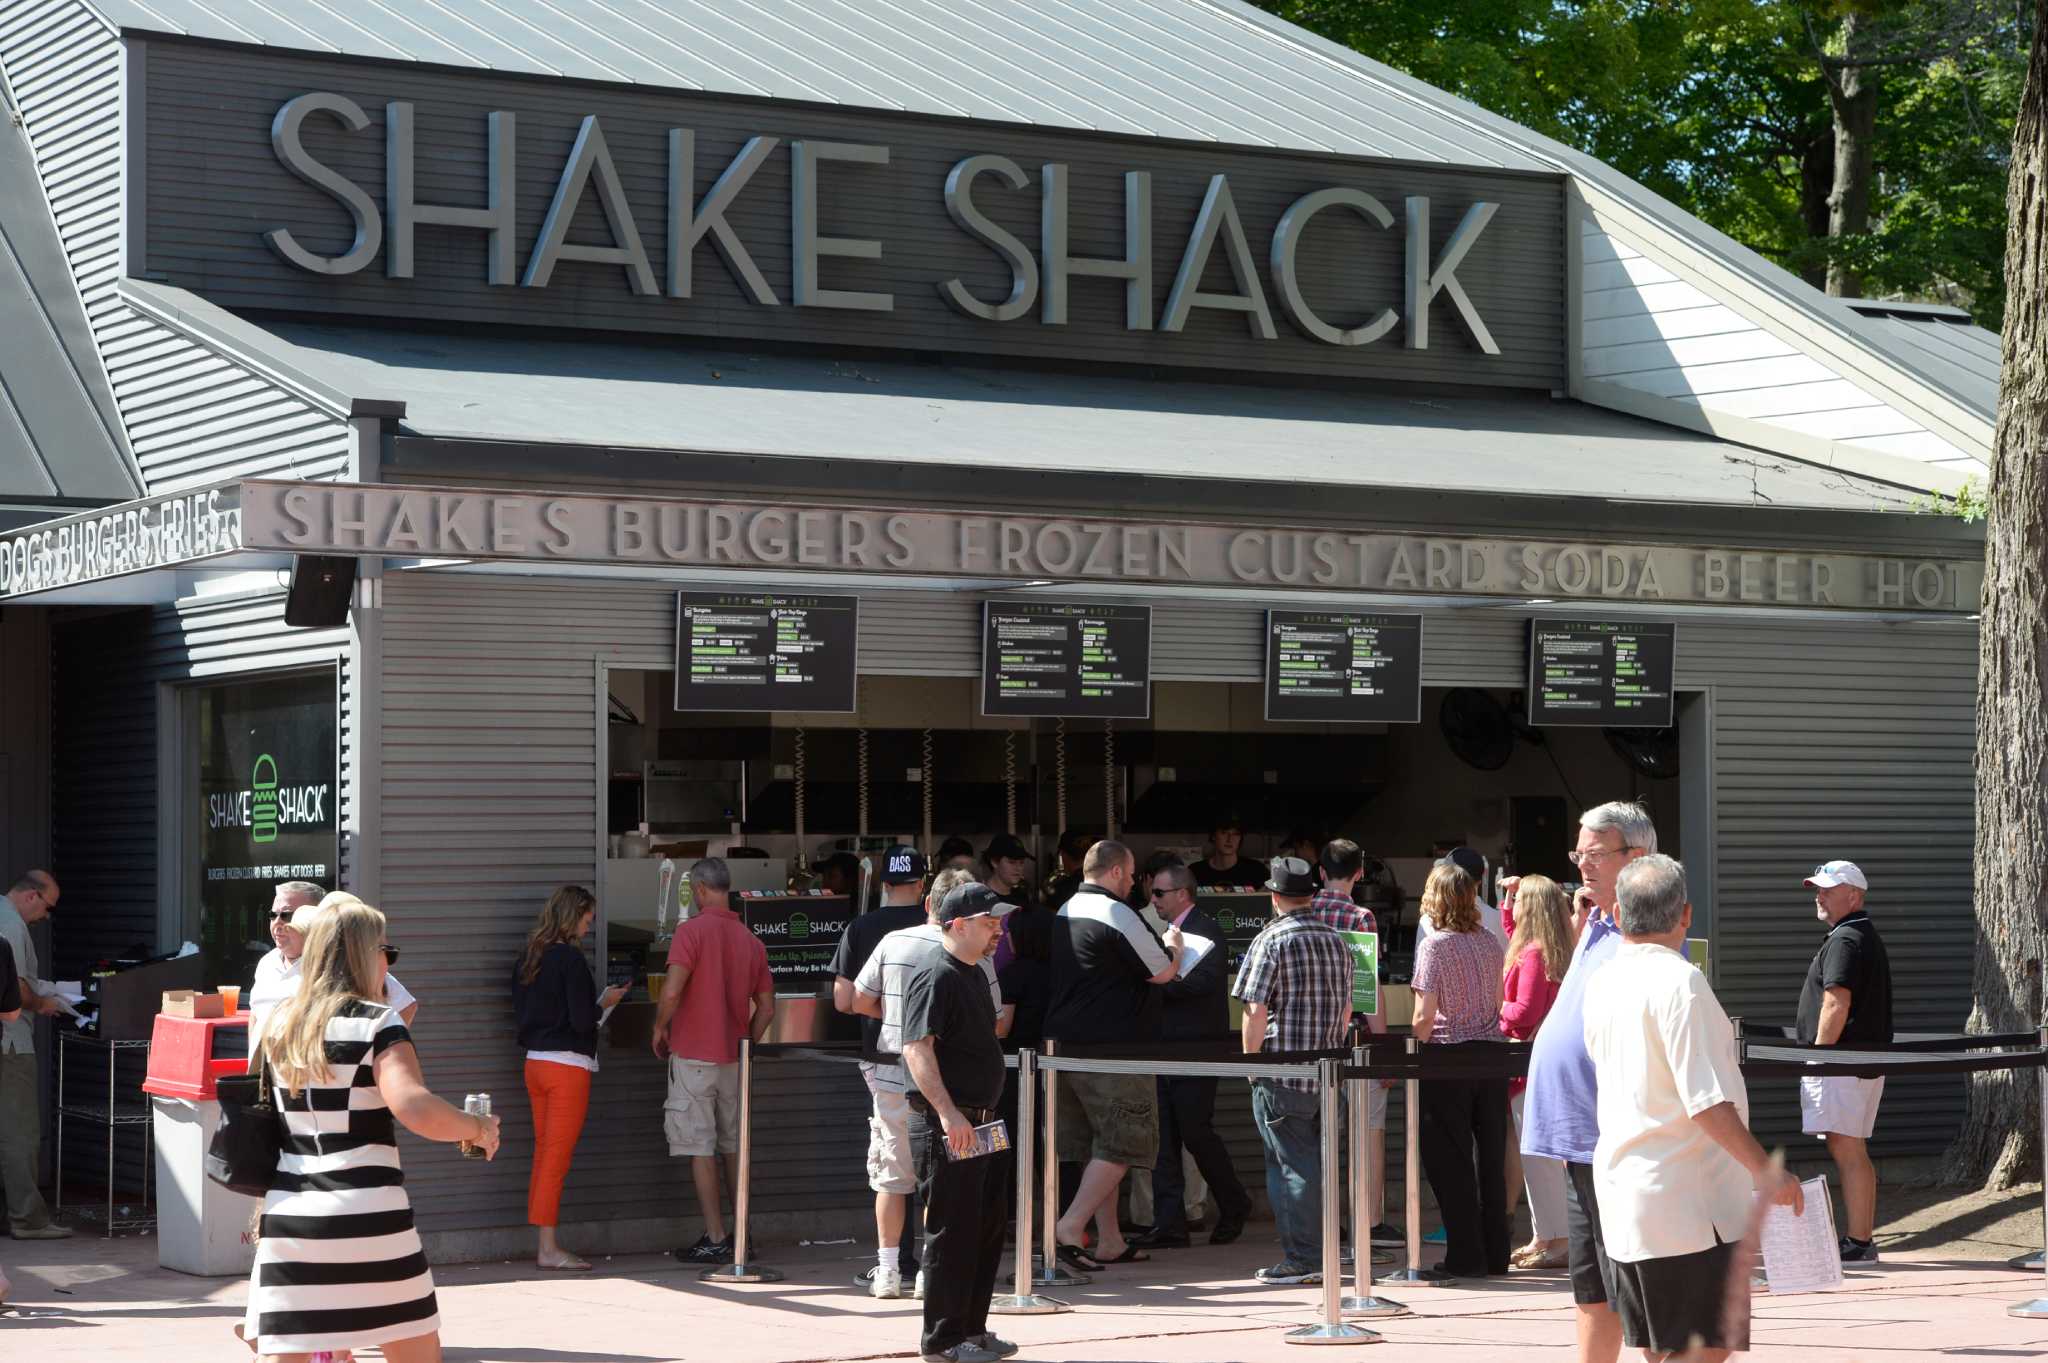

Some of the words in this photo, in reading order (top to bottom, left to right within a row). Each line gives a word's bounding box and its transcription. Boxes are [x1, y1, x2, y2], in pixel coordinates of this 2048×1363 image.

[263, 93, 894, 311] SHAKE
[939, 154, 1502, 355] SHACK
[0, 530, 53, 591] DOGS
[58, 507, 151, 576] BURGERS
[160, 489, 221, 556] FRIES
[281, 488, 576, 555] SHAKES
[613, 504, 914, 568] BURGERS
[960, 519, 1193, 579] FROZEN
[1229, 531, 1488, 590] CUSTARD
[1520, 546, 1665, 599] SODA
[1704, 552, 1836, 604] BEER
[1877, 559, 1970, 608] HOT
[209, 790, 252, 829] SHAKE
[278, 785, 325, 824] SHACK
[889, 855, 912, 873] BASS
[753, 922, 788, 935] SHAKE
[810, 921, 845, 934] SHACK
[1235, 917, 1266, 928] SHACK
